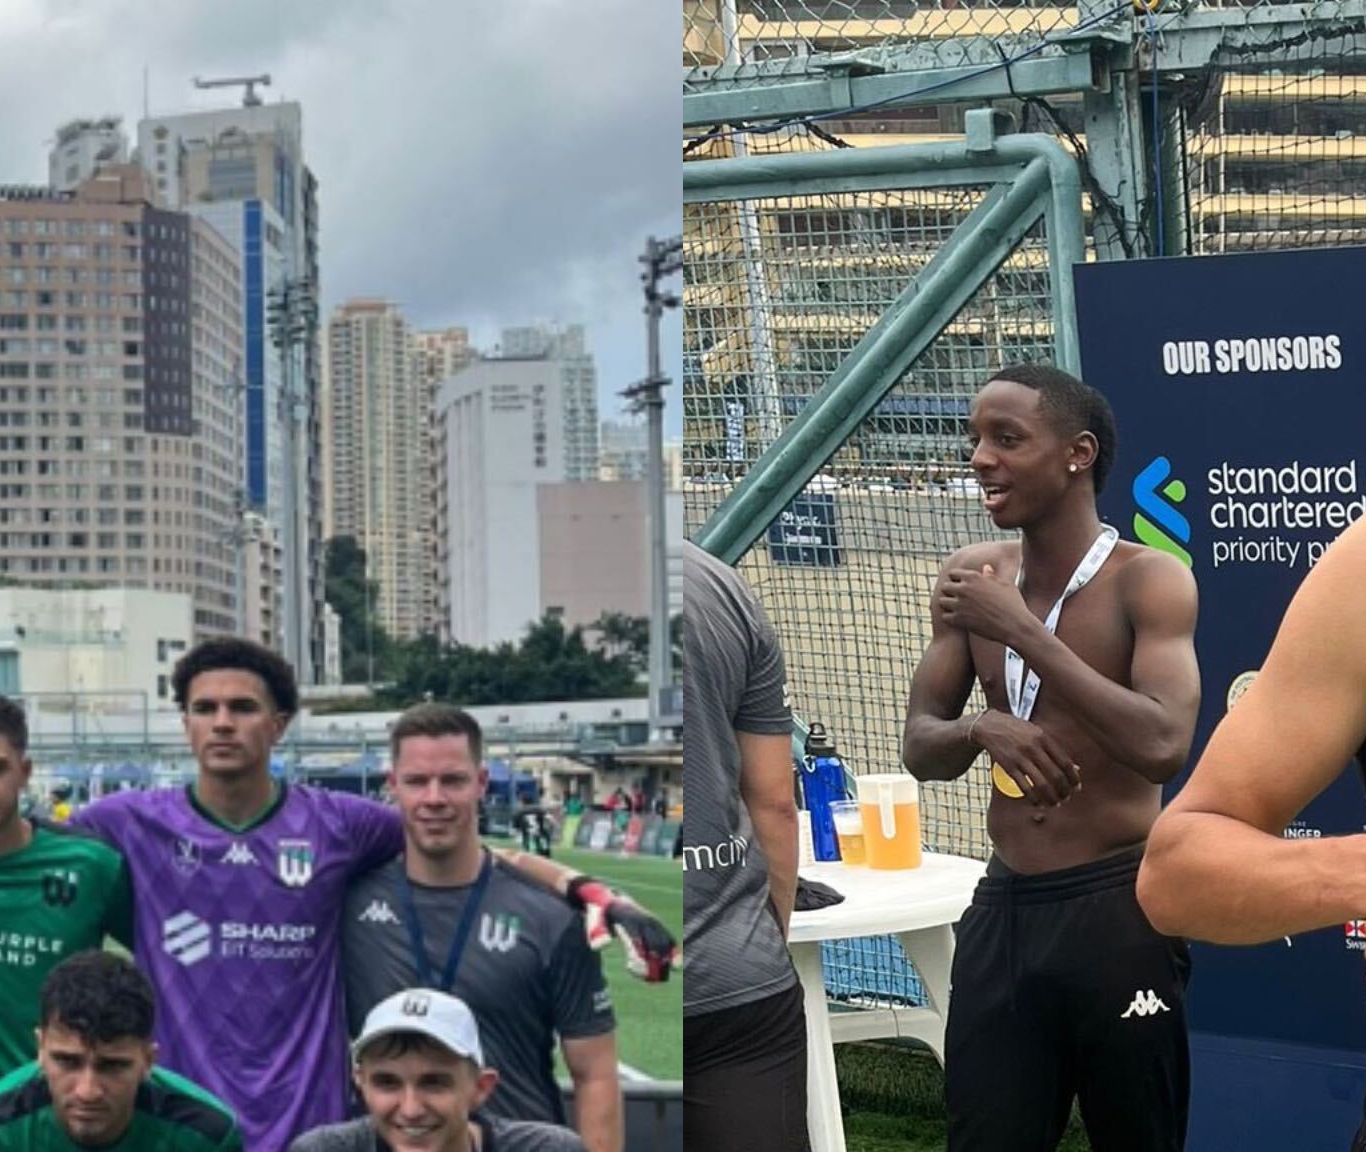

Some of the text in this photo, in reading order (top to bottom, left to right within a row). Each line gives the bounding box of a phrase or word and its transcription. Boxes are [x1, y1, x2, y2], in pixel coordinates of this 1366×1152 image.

[1163, 334, 1342, 375] OUR SPONSORS
[1208, 459, 1357, 495] standard
[1210, 495, 1366, 529] chartered
[1212, 536, 1300, 568] priority
[1284, 828, 1322, 838] INGER
[221, 923, 315, 941] SHARP
